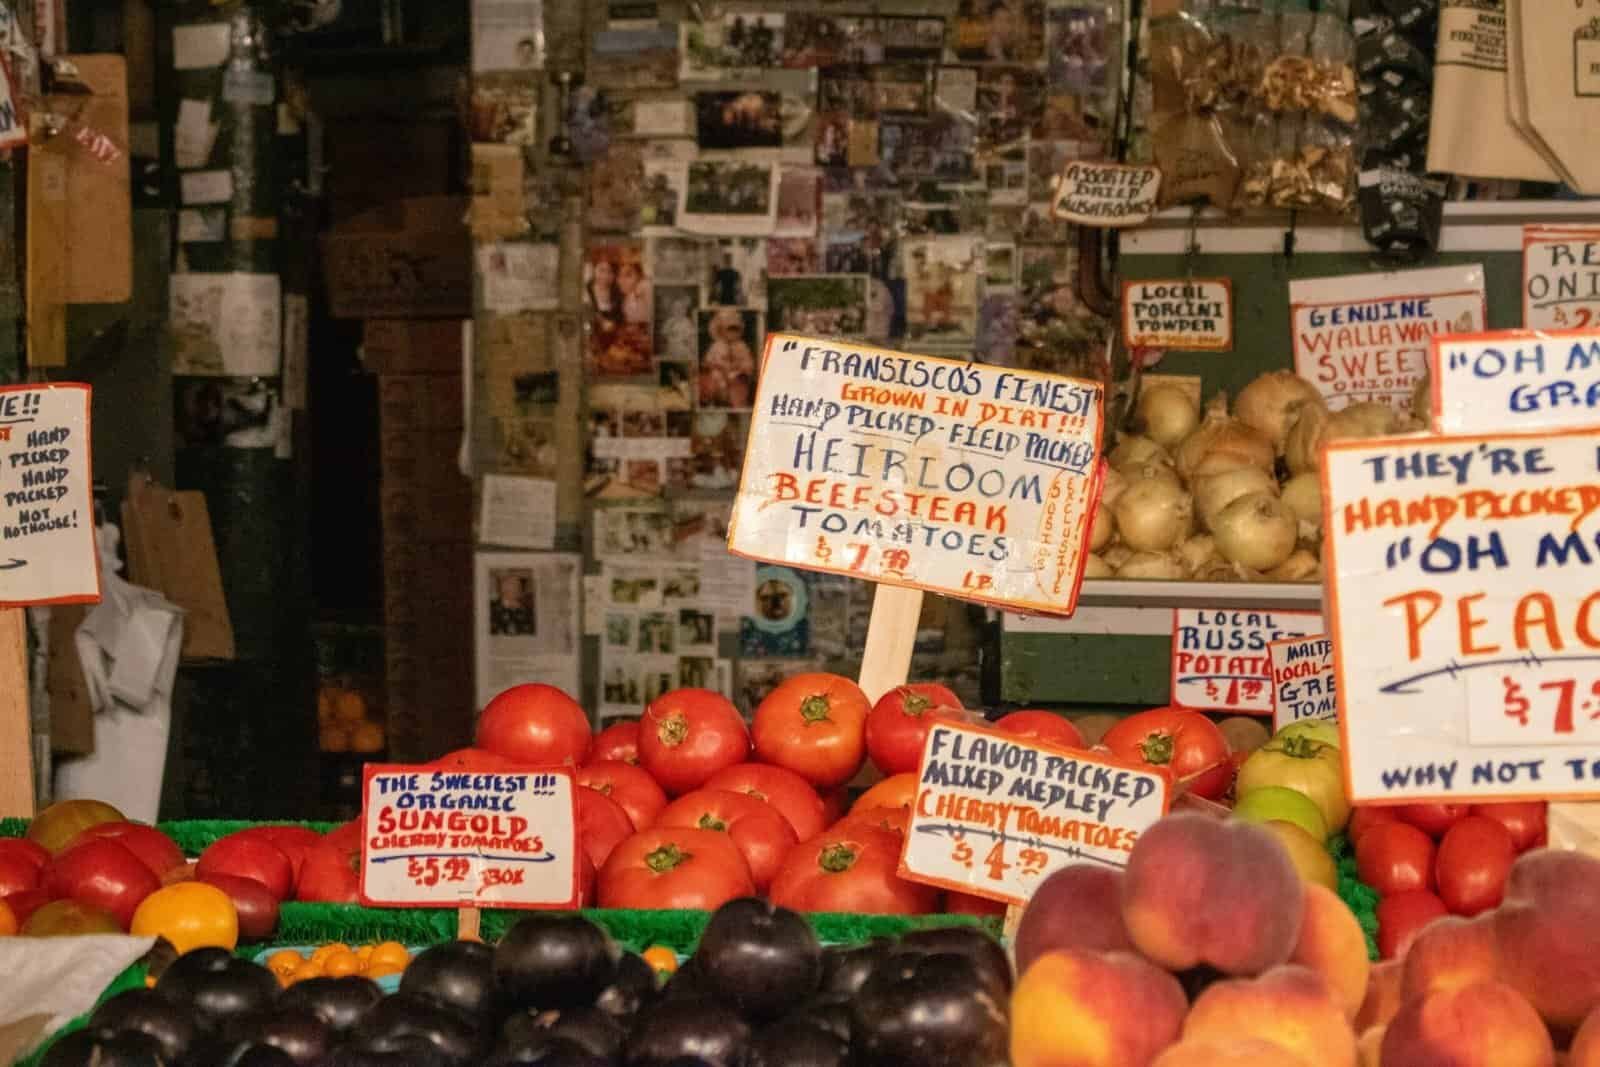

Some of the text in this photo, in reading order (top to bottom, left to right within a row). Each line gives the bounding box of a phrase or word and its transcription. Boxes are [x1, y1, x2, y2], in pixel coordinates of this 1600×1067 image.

[1141, 285, 1209, 300] LOCAL
[1133, 302, 1224, 319] PORCINI
[1310, 300, 1433, 328] GENUINE
[1136, 319, 1216, 333] POWDER
[1301, 323, 1392, 353] WALLA
[840, 382, 927, 410] GROWN
[933, 396, 969, 417] IN
[27, 427, 70, 448] HAND
[770, 393, 841, 430] HAND
[1025, 432, 1094, 469] PACKED
[9, 448, 69, 468] PICKED
[793, 432, 1042, 504] HEIRLOOM
[1363, 443, 1554, 484] THEY'RE
[22, 466, 69, 488] HAND
[4, 485, 68, 507] PACKED
[766, 472, 1007, 534] BEEFSTEAK
[19, 507, 51, 524] NOT
[792, 506, 1009, 560] TOMATOES
[1536, 531, 1600, 568] M
[1197, 610, 1277, 628] LOCAL
[1178, 626, 1305, 651] RUSS
[1288, 696, 1336, 719] TOM
[931, 728, 1156, 807] FLAVOR PACKED
[1381, 760, 1458, 791] WHY
[1472, 758, 1545, 785] NOT
[376, 774, 420, 794] THE
[431, 771, 528, 793] SWEETEST
[922, 759, 1116, 821] MIXED MEDLEY
[396, 793, 516, 812] ORGANIC
[377, 806, 528, 838] SUNGOLD
[477, 868, 525, 895] BOX
